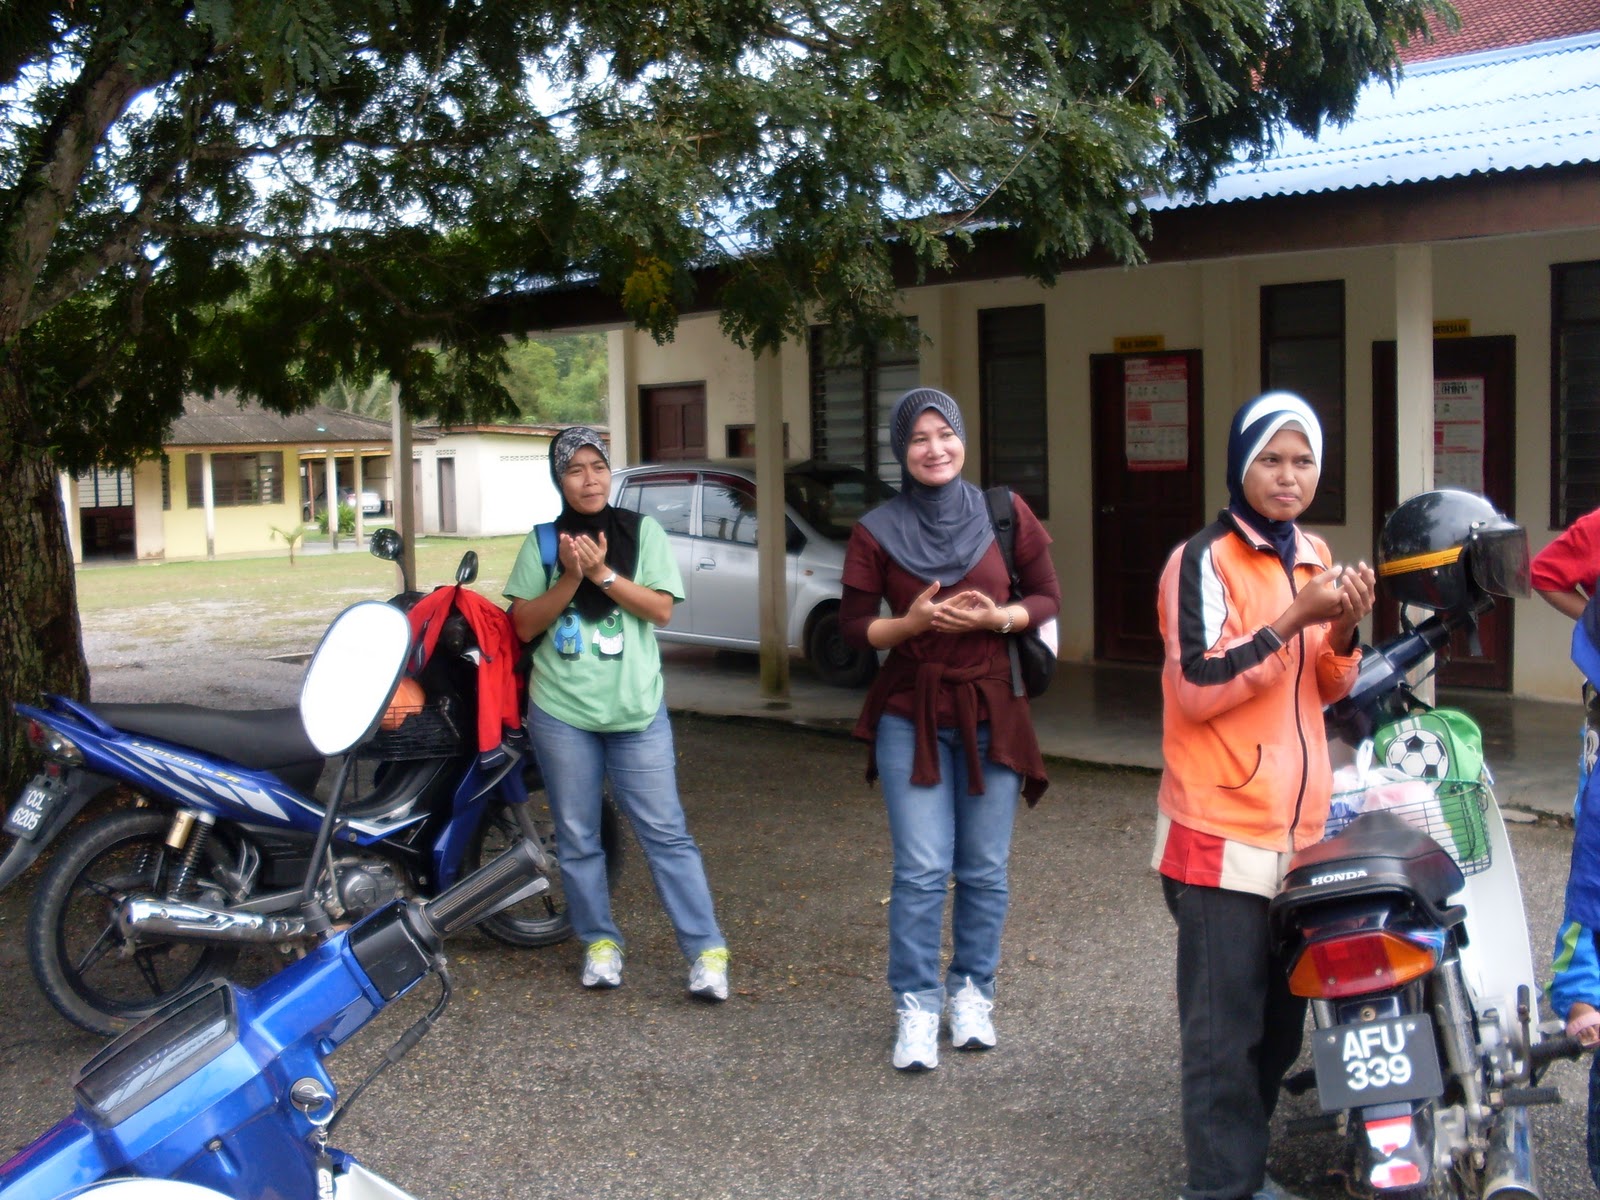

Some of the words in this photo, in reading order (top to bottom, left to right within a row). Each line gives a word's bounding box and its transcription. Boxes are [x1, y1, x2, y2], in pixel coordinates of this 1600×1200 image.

[26, 790, 46, 811] CCL
[12, 807, 42, 831] 6205
[1311, 870, 1368, 886] HONDA
[1343, 1023, 1405, 1062] AFU
[1346, 1053, 1412, 1091] 339
